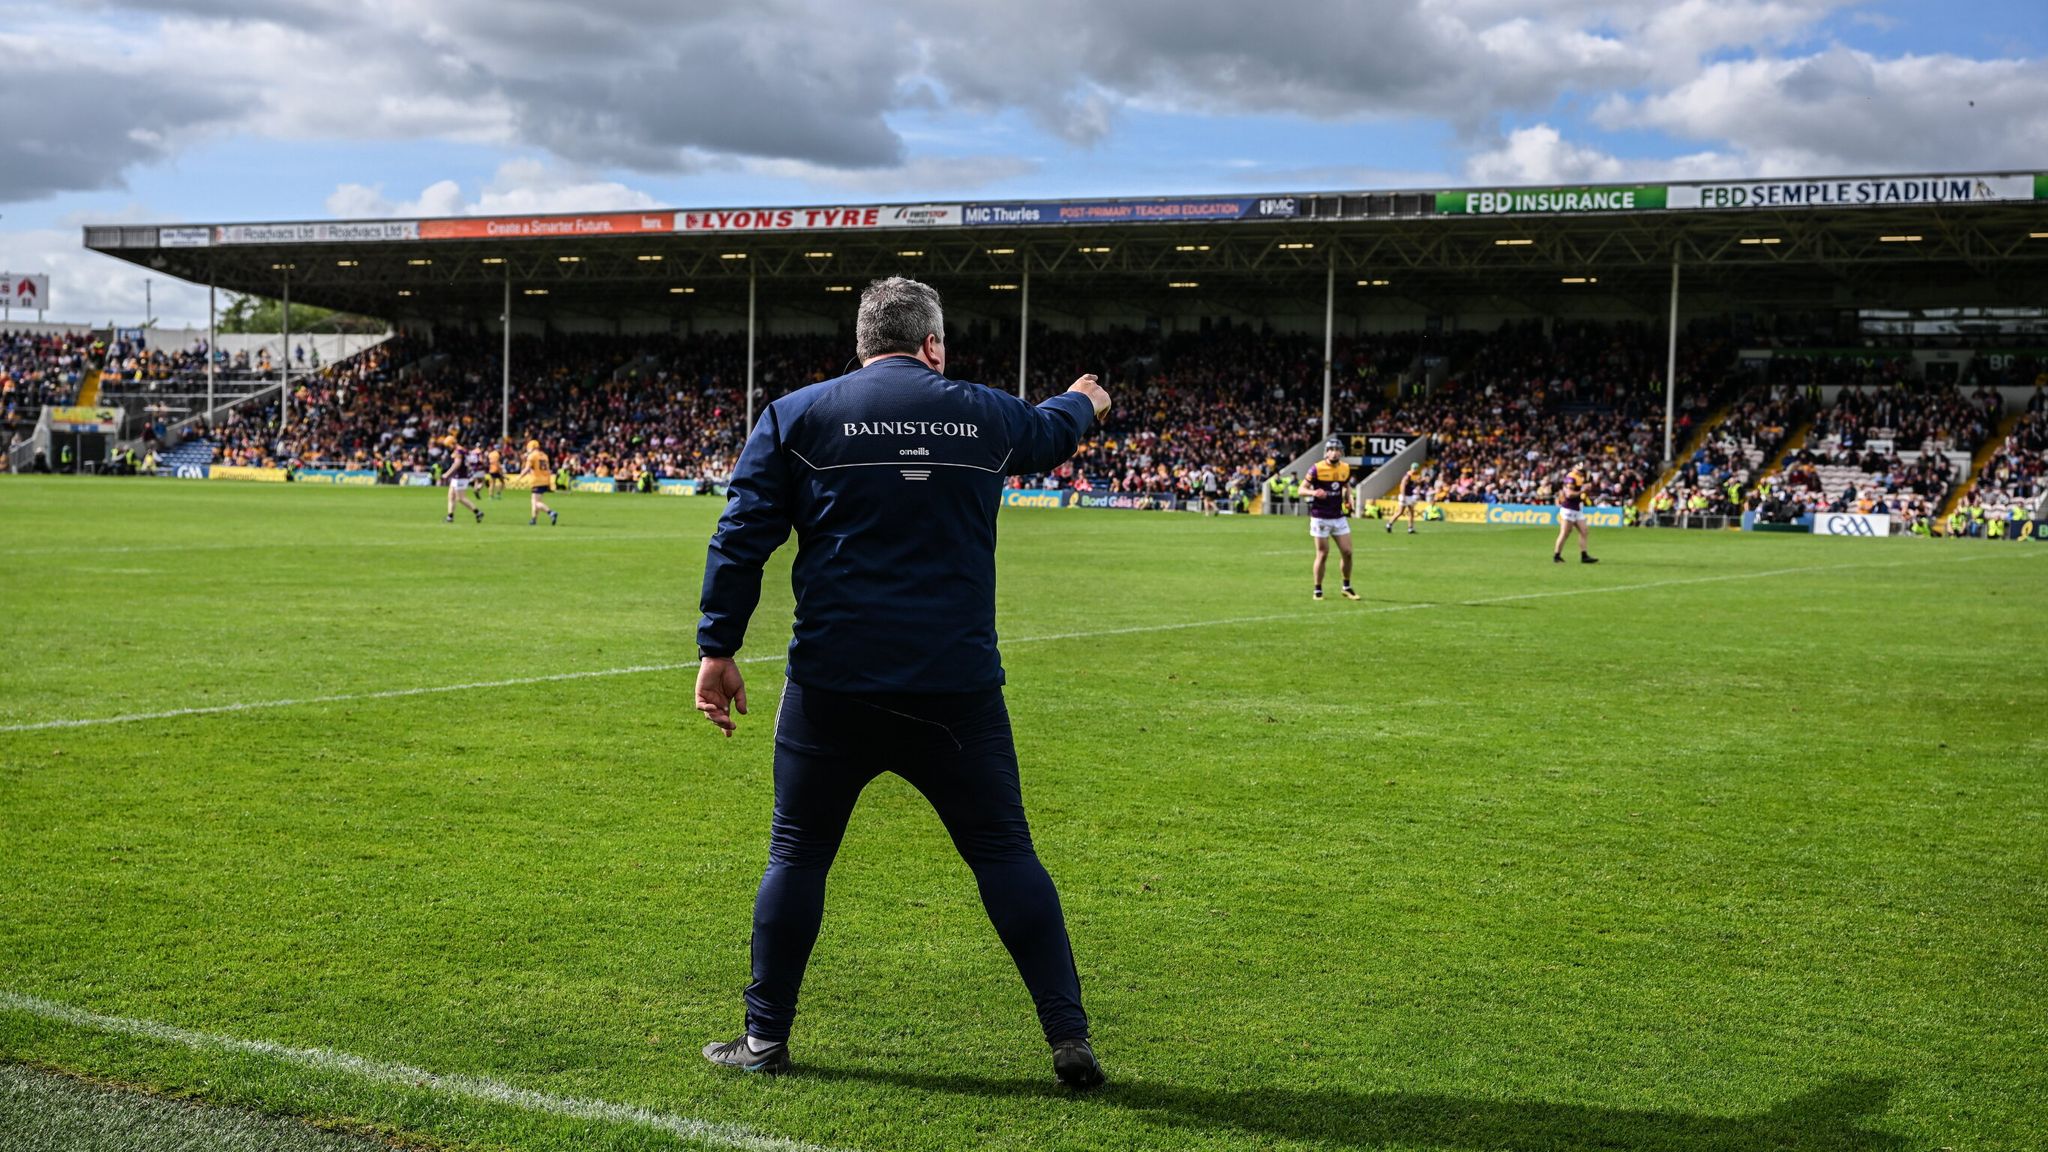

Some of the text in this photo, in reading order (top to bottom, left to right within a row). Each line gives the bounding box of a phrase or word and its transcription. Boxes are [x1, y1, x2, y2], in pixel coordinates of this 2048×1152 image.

[1701, 179, 1972, 207] FBD SEMPLE STADIUM
[1059, 203, 1240, 218] POST-PRIMARY TEACHER EDUCATION
[1466, 191, 1635, 213] FBD INSURANCE
[701, 208, 880, 229] LYONS TYRE
[965, 206, 1040, 222] MIC Thurles
[487, 220, 521, 235] Create
[523, 223, 530, 233] a
[531, 218, 573, 234] Smarter
[843, 421, 979, 438] BAINISTEOIR
[1369, 438, 1407, 455] TUS
[1008, 493, 1060, 507] Centra
[1081, 493, 1107, 506] Bord
[1489, 508, 1551, 524] Centra
